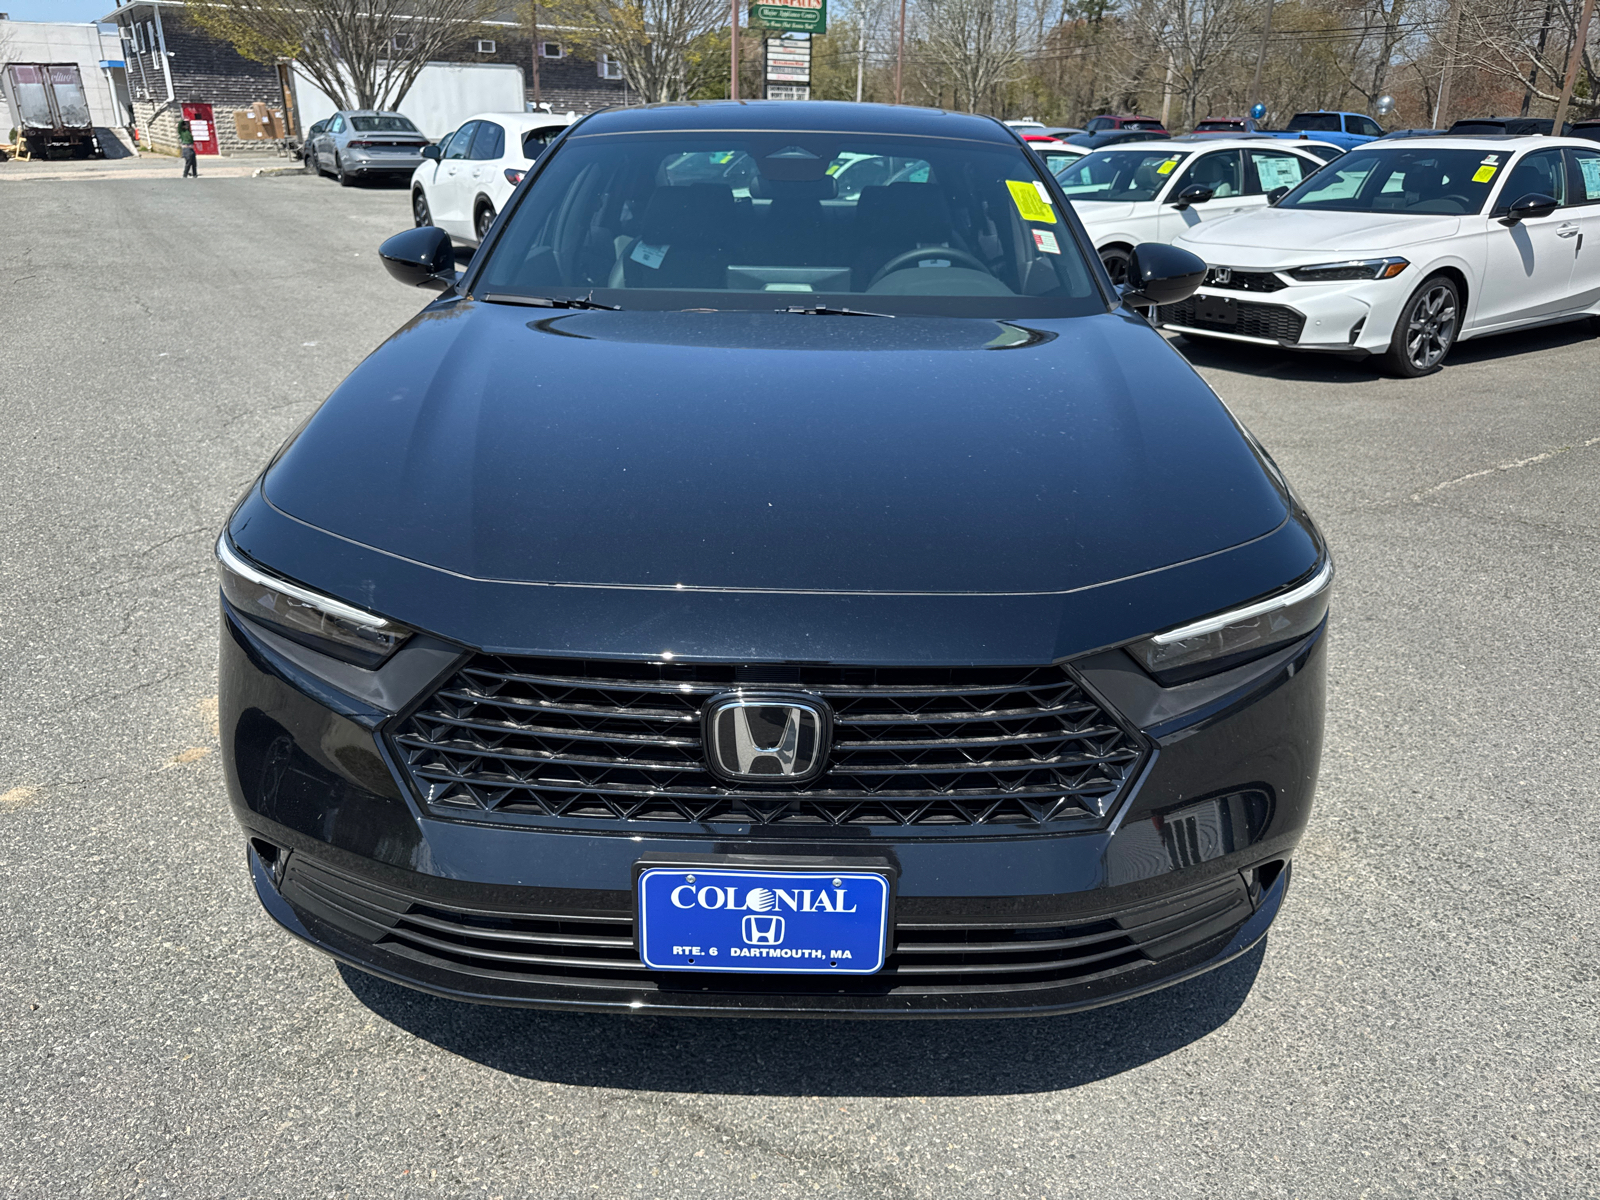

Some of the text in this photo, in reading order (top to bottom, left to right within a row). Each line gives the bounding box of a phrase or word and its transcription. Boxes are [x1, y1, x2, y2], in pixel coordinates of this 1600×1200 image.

[670, 885, 857, 913] COLONIAL
[673, 946, 852, 960] RTE. 6 DARTMOUTH, MA
